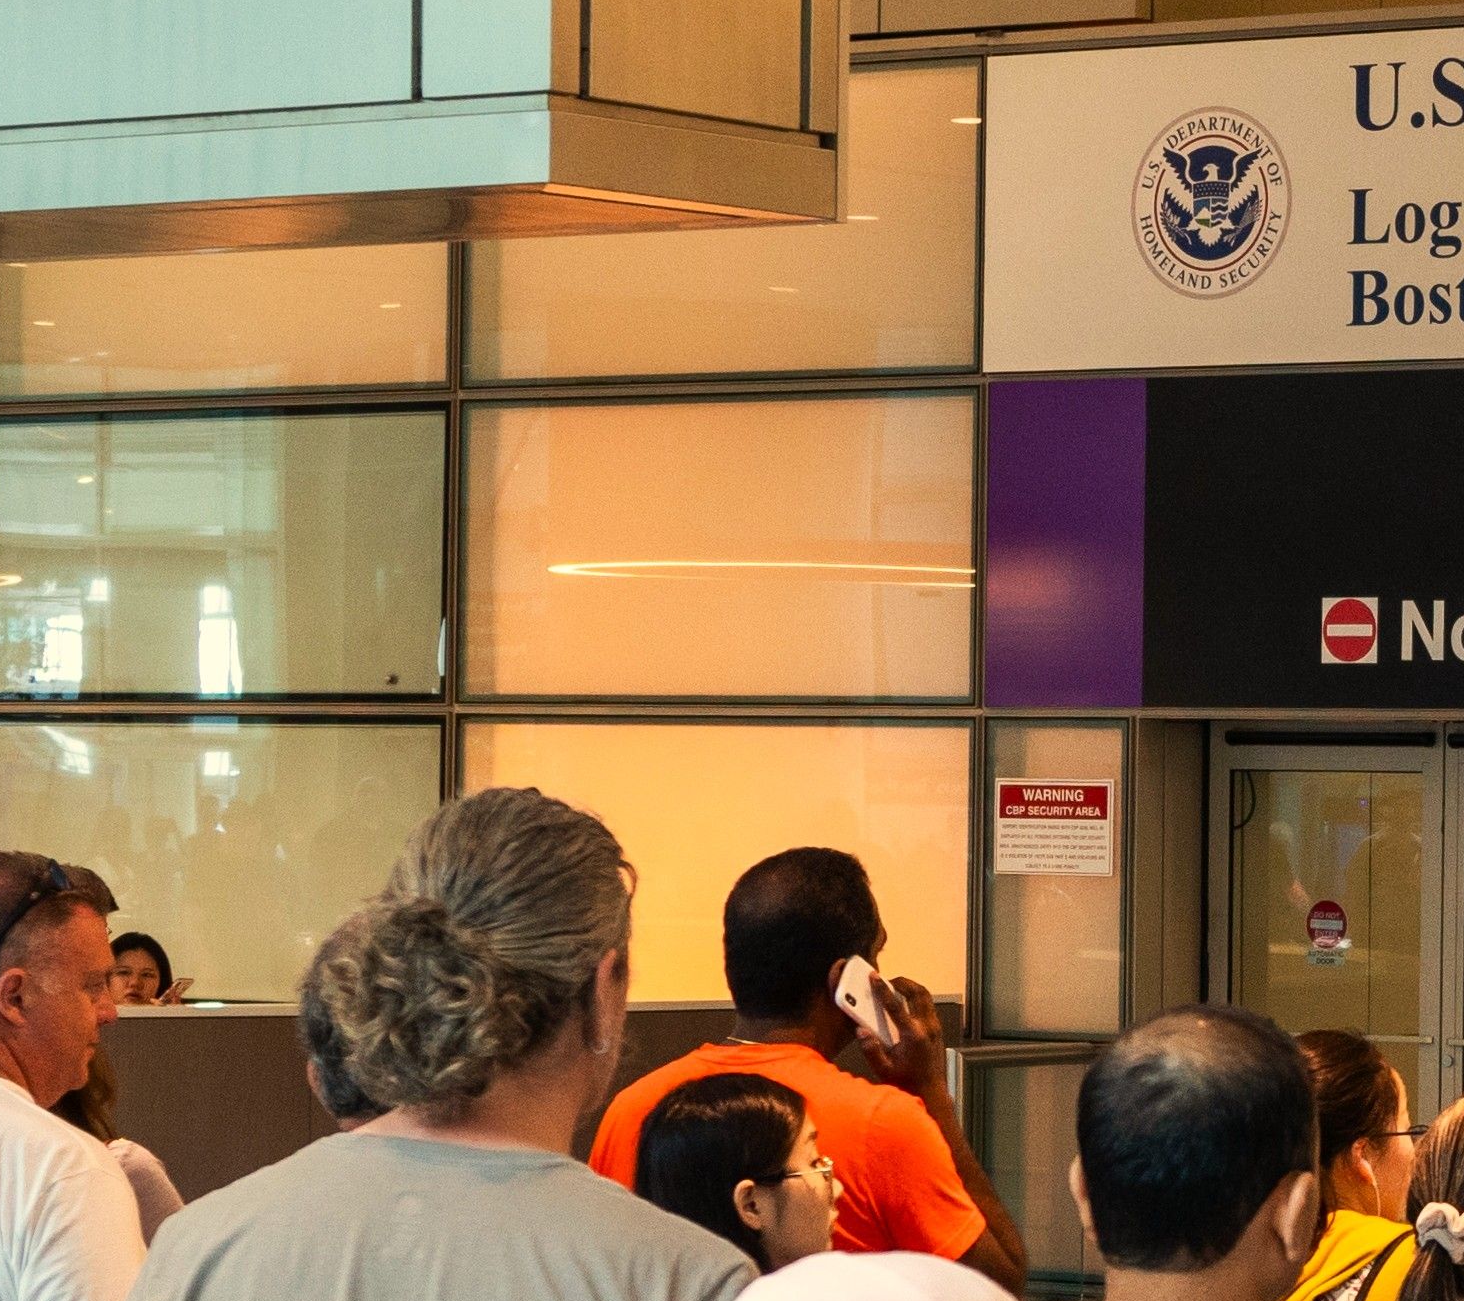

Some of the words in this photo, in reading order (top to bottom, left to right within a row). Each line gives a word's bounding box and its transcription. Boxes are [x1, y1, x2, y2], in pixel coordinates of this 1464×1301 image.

[1141, 160, 1163, 190] U.S.
[1165, 116, 1272, 159] DEPARTMENT
[1267, 162, 1283, 187] OF
[1140, 214, 1211, 289] HOMELAND
[1220, 211, 1282, 288] SECURITY
[1006, 805, 1025, 815] CBP
[1028, 806, 1073, 816] SECURITY
[1075, 807, 1101, 817] AREA
[1023, 789, 1084, 802] WARNING
